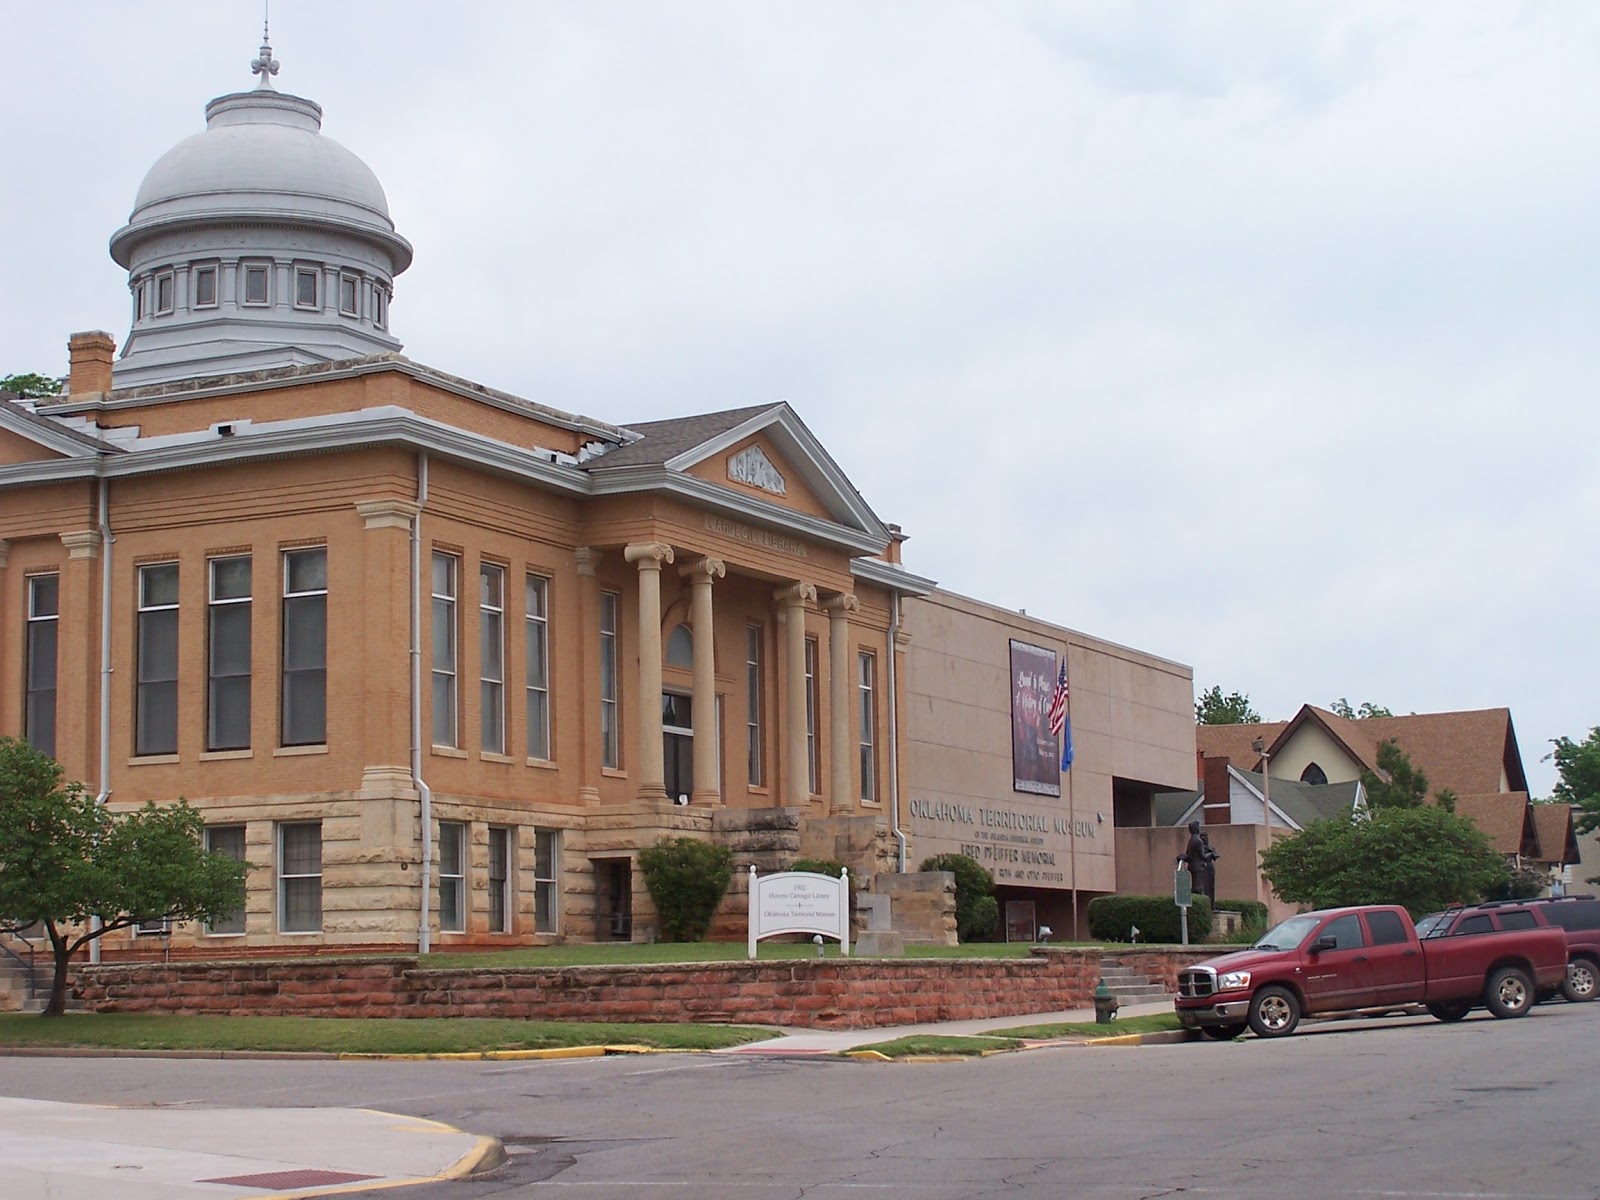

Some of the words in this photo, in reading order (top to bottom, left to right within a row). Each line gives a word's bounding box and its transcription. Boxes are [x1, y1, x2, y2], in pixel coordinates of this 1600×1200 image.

[910, 800, 974, 825] OKLAHOMA
[979, 808, 1049, 833] TERRITORIAL
[1053, 818, 1096, 838] MUSEUM
[961, 843, 980, 859] FRED
[1022, 850, 1056, 866] MEMORIAL
[812, 892, 830, 900] Library
